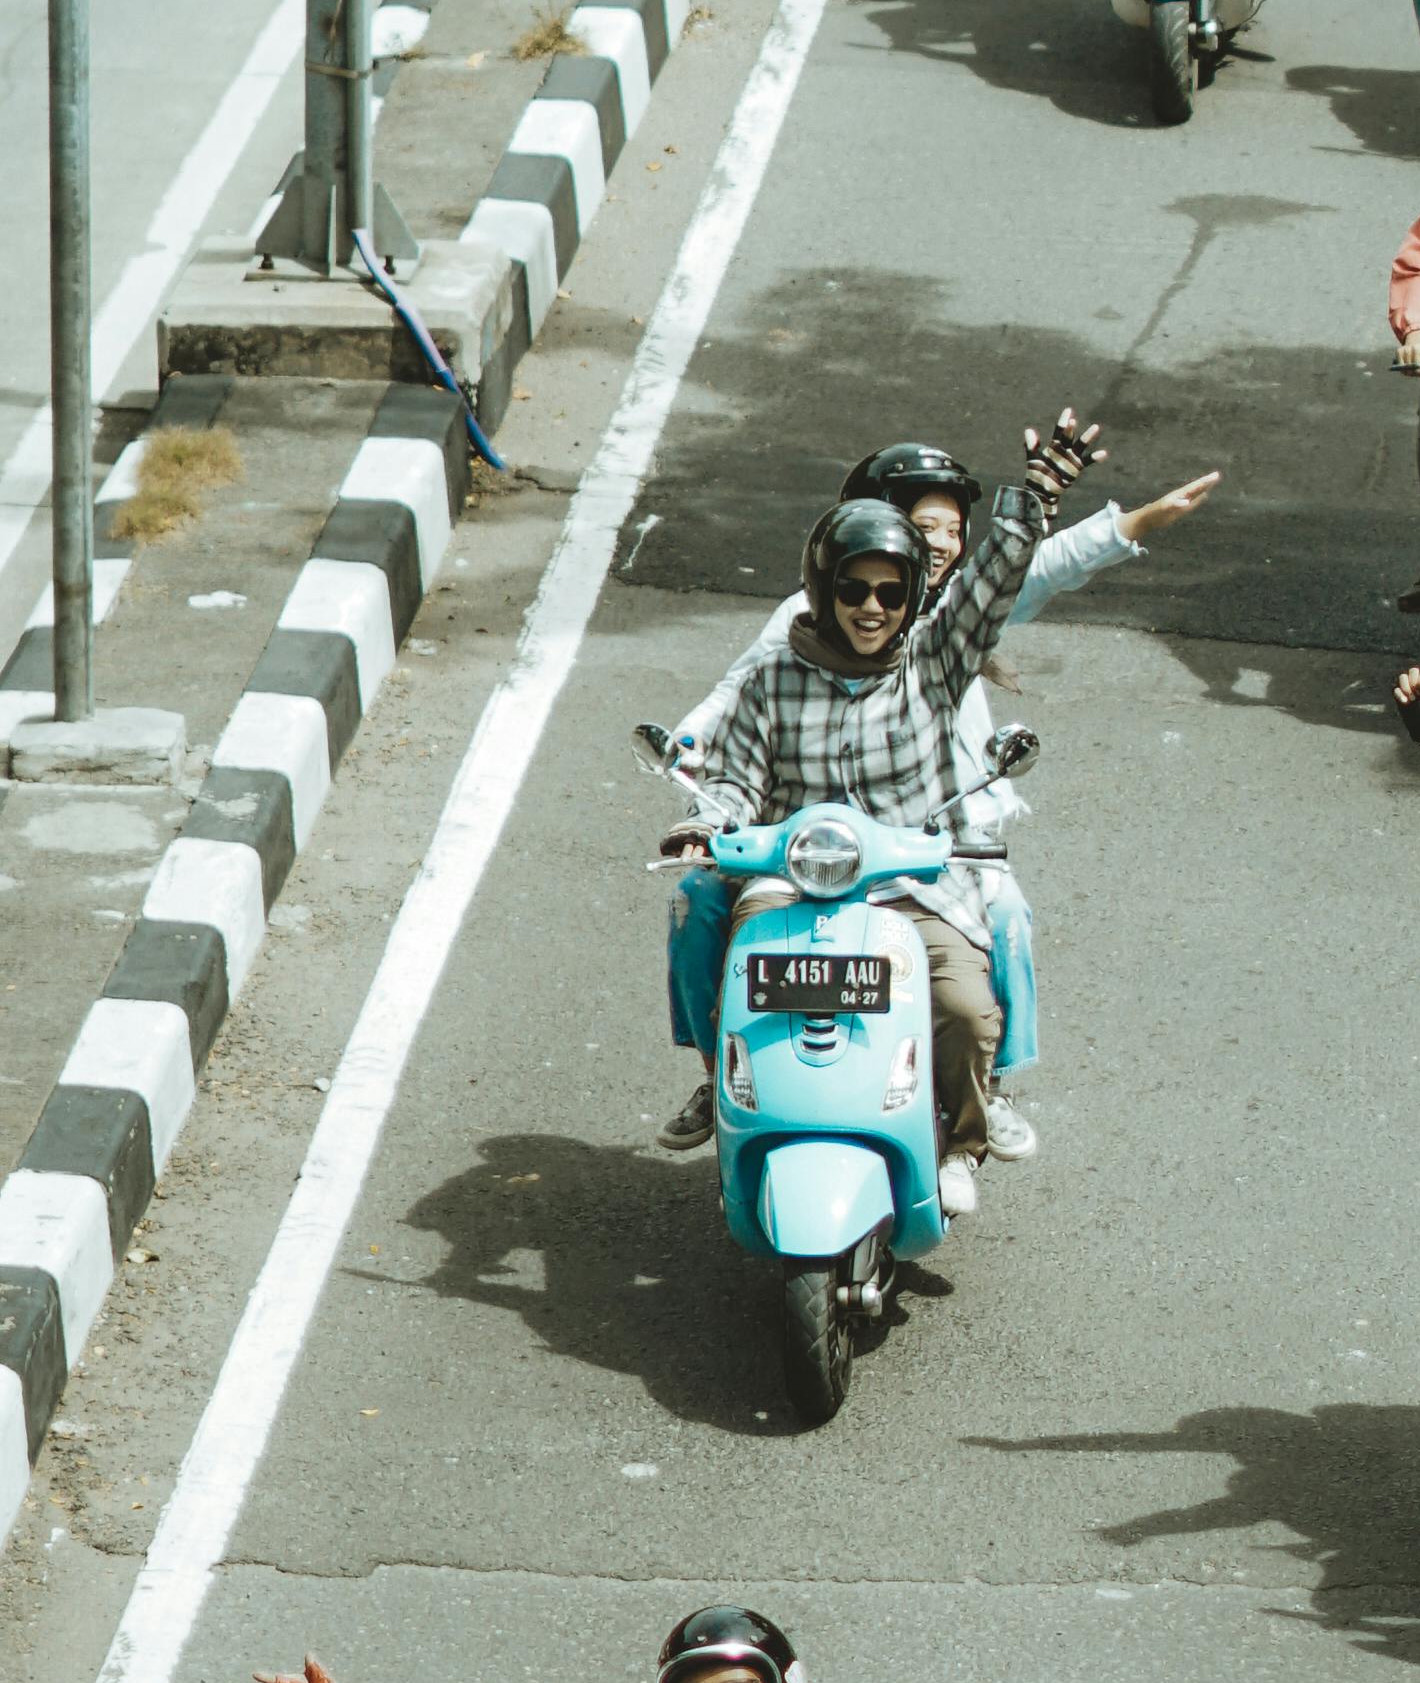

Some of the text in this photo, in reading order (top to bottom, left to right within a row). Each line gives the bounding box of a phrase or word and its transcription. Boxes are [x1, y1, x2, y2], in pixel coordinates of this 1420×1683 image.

[757, 959, 769, 984] L
[784, 959, 831, 985] 4151
[844, 960, 881, 986] AAU
